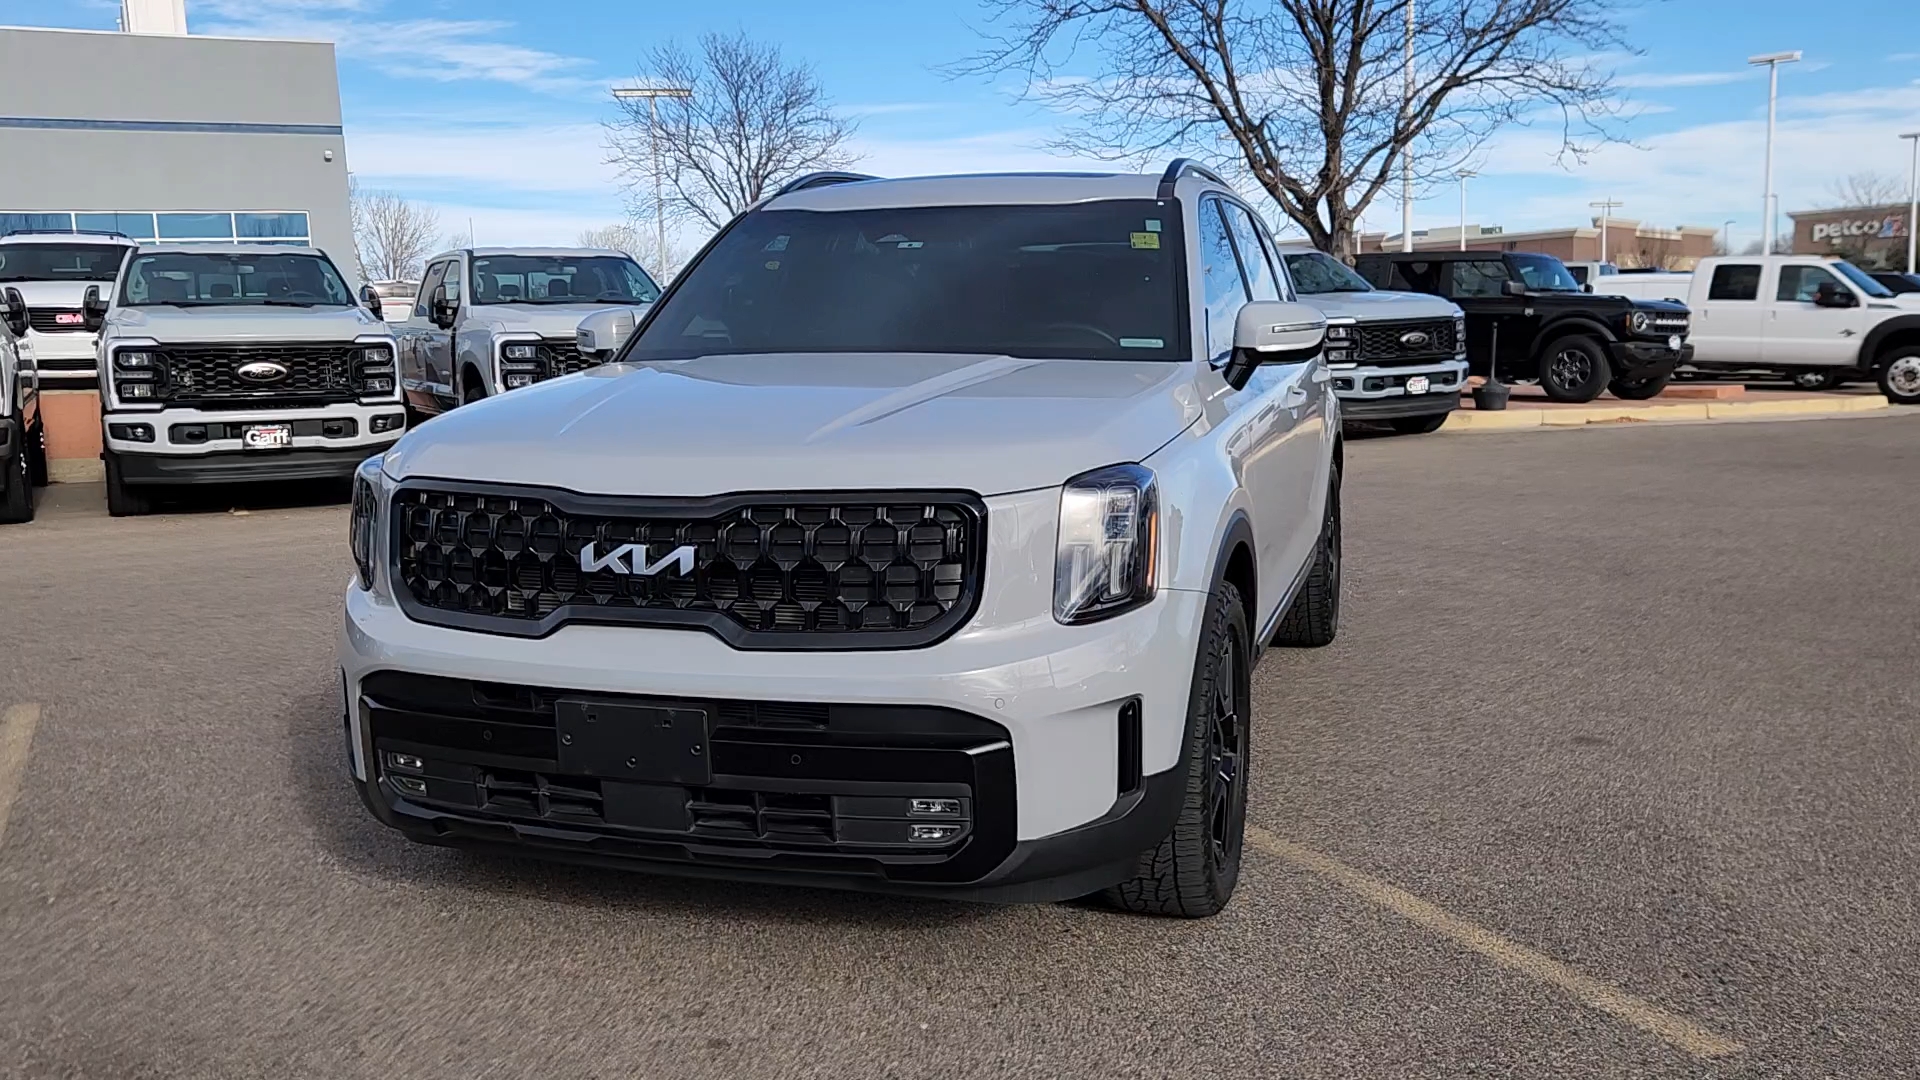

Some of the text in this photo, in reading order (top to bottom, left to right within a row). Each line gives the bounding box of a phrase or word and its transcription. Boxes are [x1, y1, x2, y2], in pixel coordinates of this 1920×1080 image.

[1813, 219, 1880, 242] petco
[55, 314, 84, 323] GM
[246, 429, 289, 446] Garff
